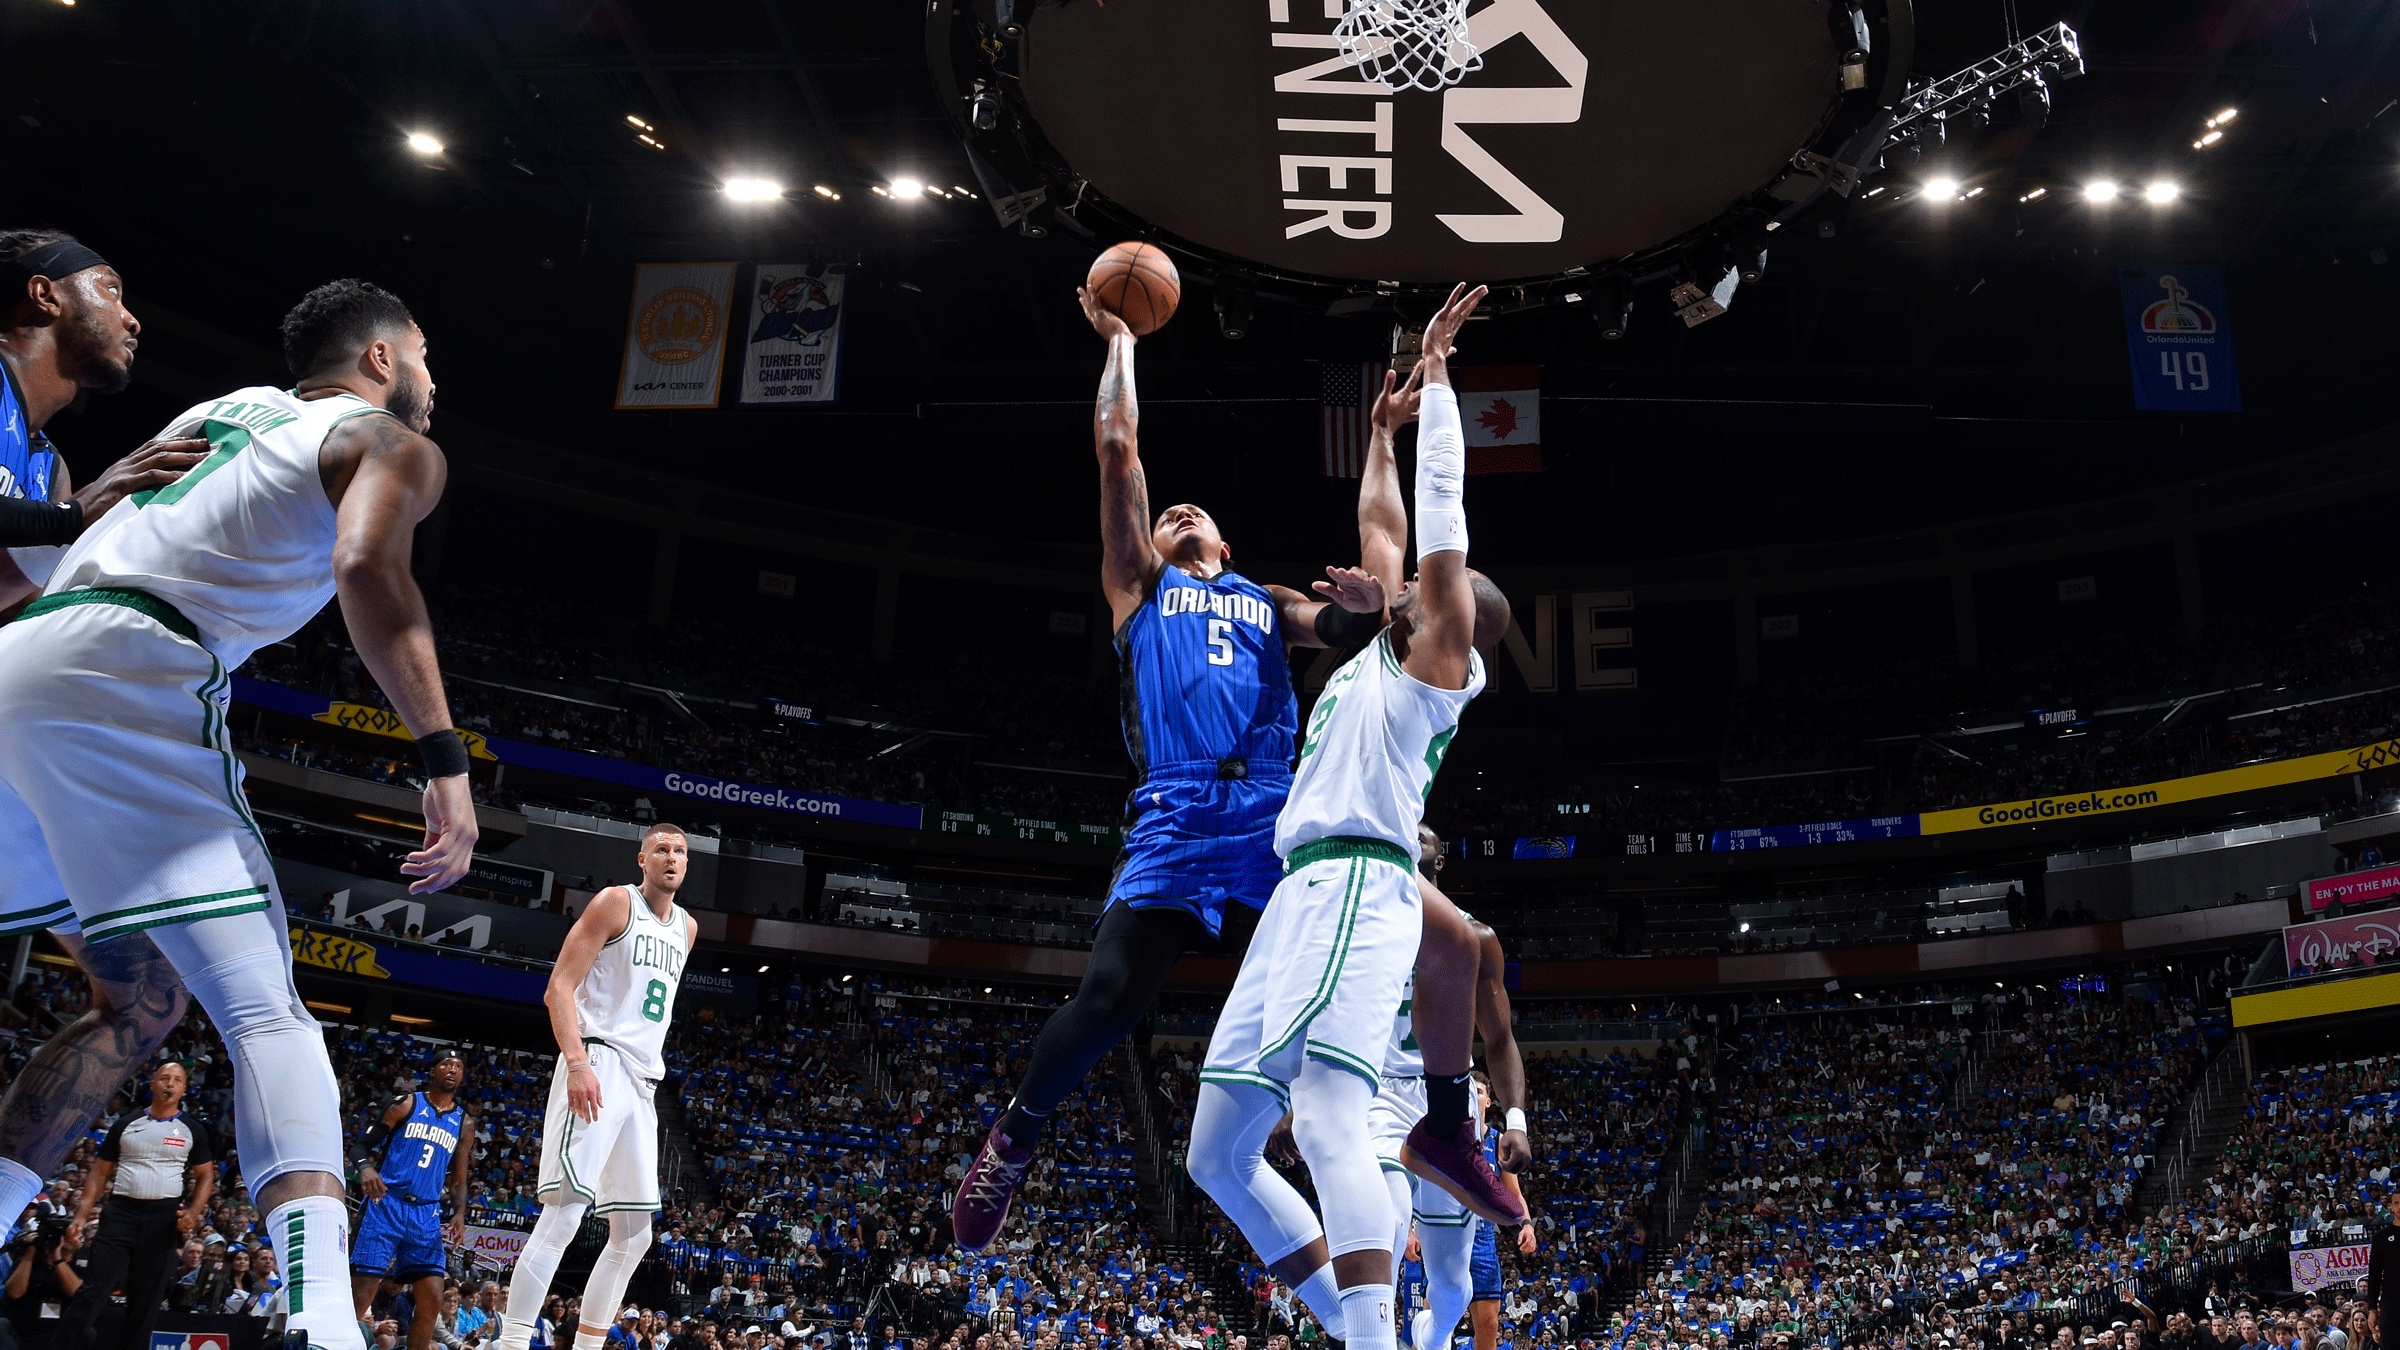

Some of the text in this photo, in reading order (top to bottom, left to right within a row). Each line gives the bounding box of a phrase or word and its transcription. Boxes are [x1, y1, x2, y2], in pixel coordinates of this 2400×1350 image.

[2146, 335, 2215, 344] OrlandoUnited
[759, 353, 826, 367] TURNER CUP
[758, 367, 822, 382] CHAMPIONS
[2161, 351, 2210, 391] 49
[669, 382, 704, 391] CENTER
[764, 385, 813, 397] 2000-2001
[208, 400, 299, 435] TATUM
[1161, 586, 1273, 636] ORLANDO
[1207, 618, 1234, 666] 5
[780, 703, 812, 720] PLAYOFFS
[2044, 709, 2078, 726] PLAYOFFS
[664, 773, 841, 816] GoodGreek.com
[1978, 788, 2159, 825] GoodGreek.com
[949, 811, 974, 823] SHOOTING
[1025, 819, 1040, 829] FIELD
[941, 820, 991, 836] 0-0 0%
[1019, 827, 1069, 843] 0-6 0%
[1811, 823, 1826, 832] FIELD
[1886, 827, 1892, 837] 2
[1627, 834, 1655, 853] TEAM 1
[1675, 832, 1705, 851] TIME 7
[1730, 837, 1778, 850] 2-3 67%
[1807, 830, 1855, 844] 1-3 33%
[1482, 839, 1495, 856] 13
[1626, 844, 1647, 855] FOULS
[1675, 842, 1693, 853] OUTS
[479, 869, 497, 880] that
[499, 874, 533, 888] inspires
[2357, 881, 2379, 894] THE
[289, 930, 368, 974] REEK
[632, 933, 684, 983] CELTICS
[685, 973, 735, 988] FANDUEL
[685, 983, 706, 991] SPORTS
[641, 978, 668, 1023] 8
[405, 1122, 458, 1154] ORLANDO
[418, 1144, 435, 1168] 3
[474, 1235, 528, 1253] AGMU.
[2325, 1246, 2369, 1268] AGM
